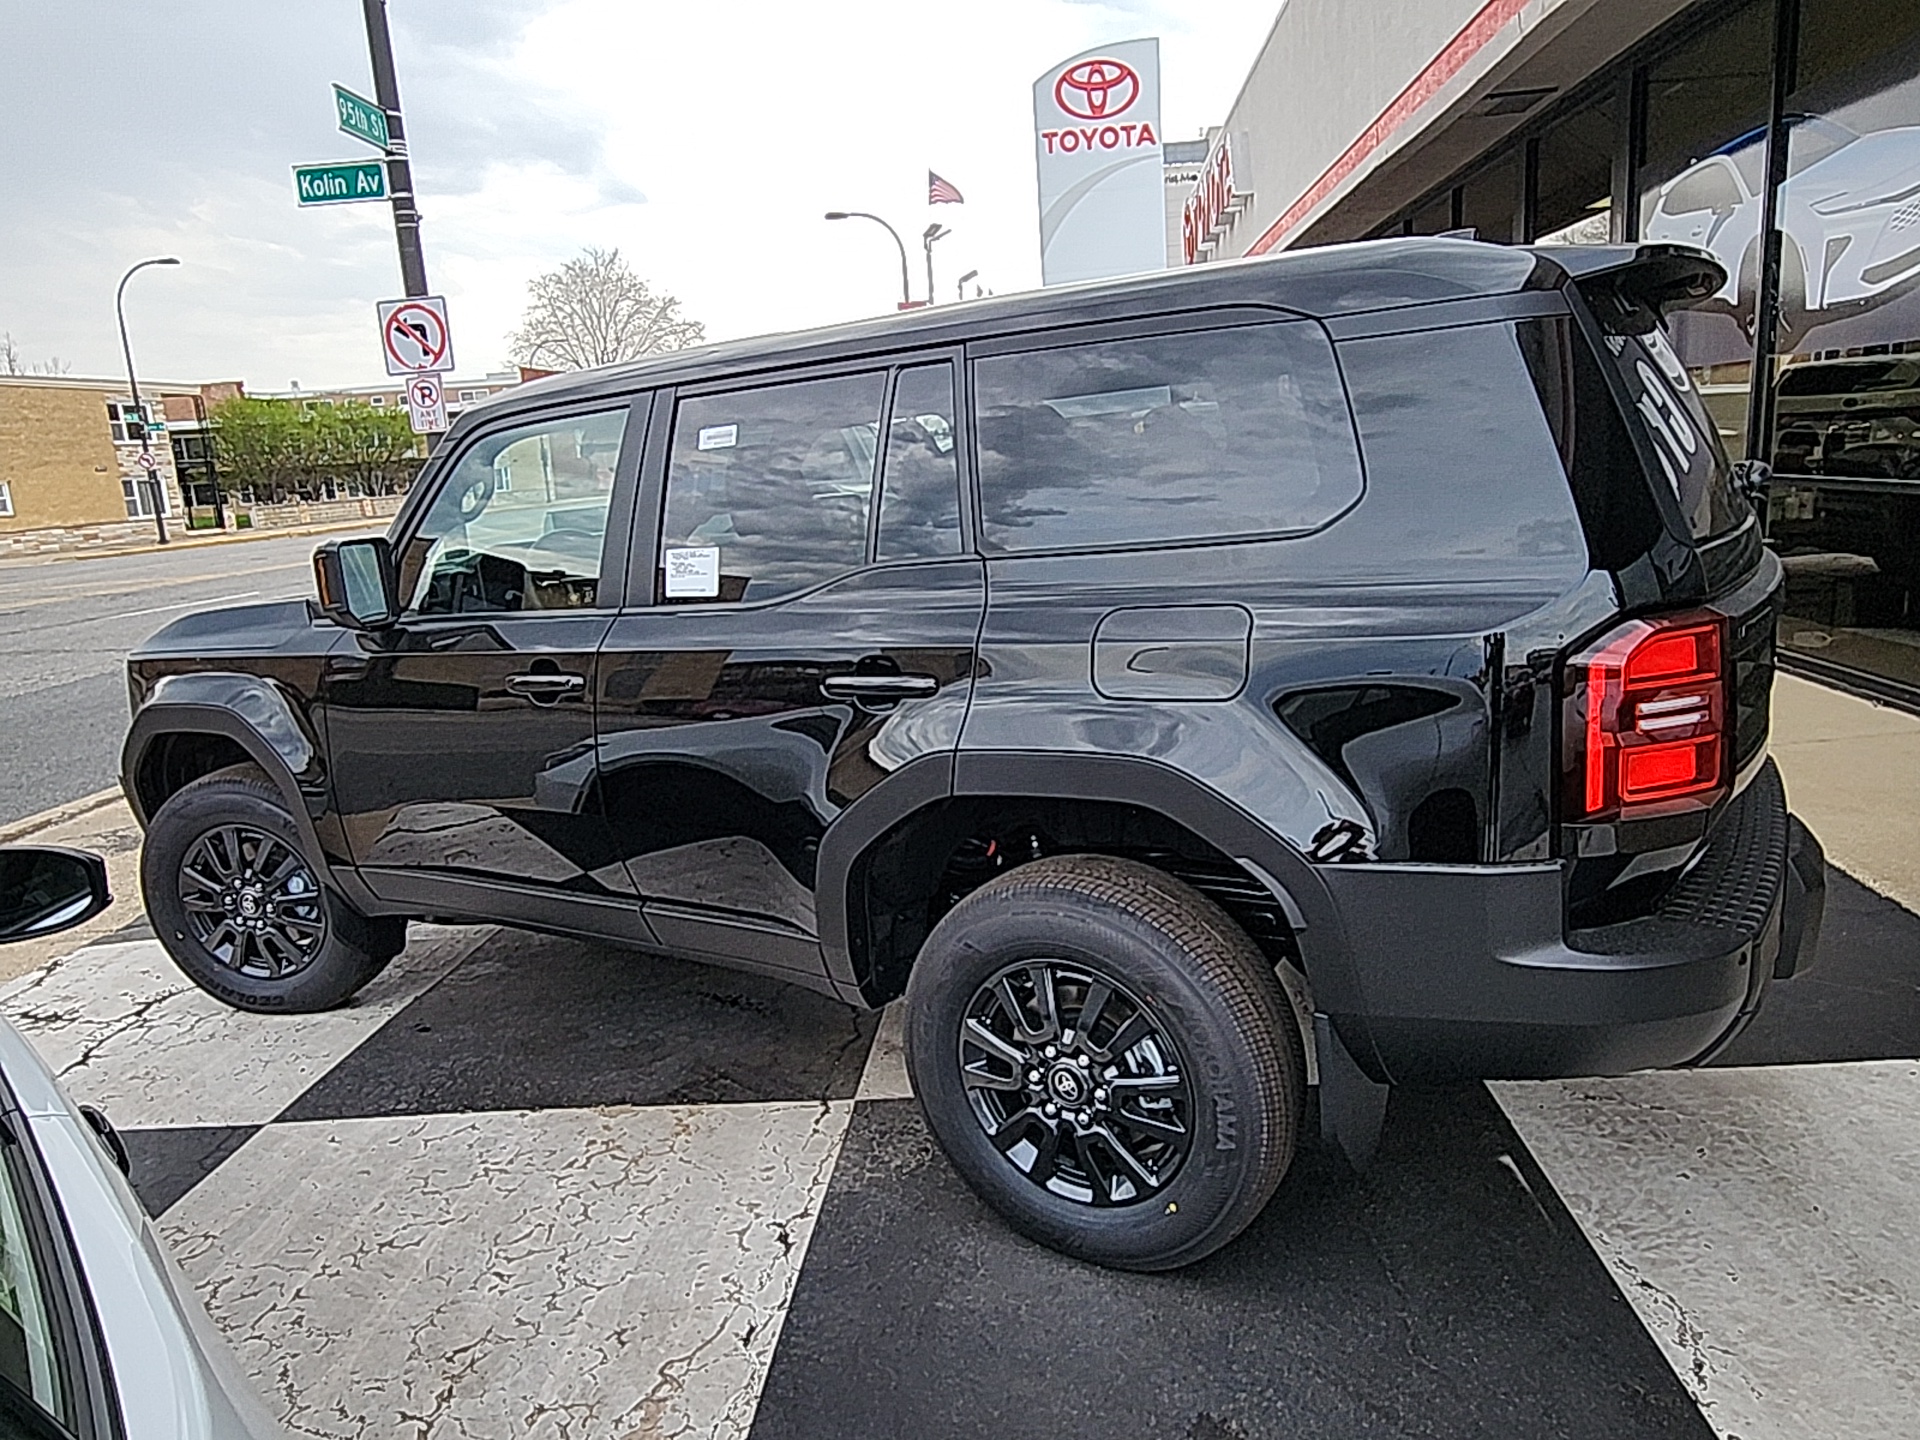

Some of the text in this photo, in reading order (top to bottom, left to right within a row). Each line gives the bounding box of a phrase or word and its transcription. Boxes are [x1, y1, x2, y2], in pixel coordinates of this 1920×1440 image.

[339, 98, 385, 140] 95th St
[1041, 123, 1157, 154] TOYOTA
[300, 169, 380, 197] Kolin Av
[420, 409, 437, 418] ANY
